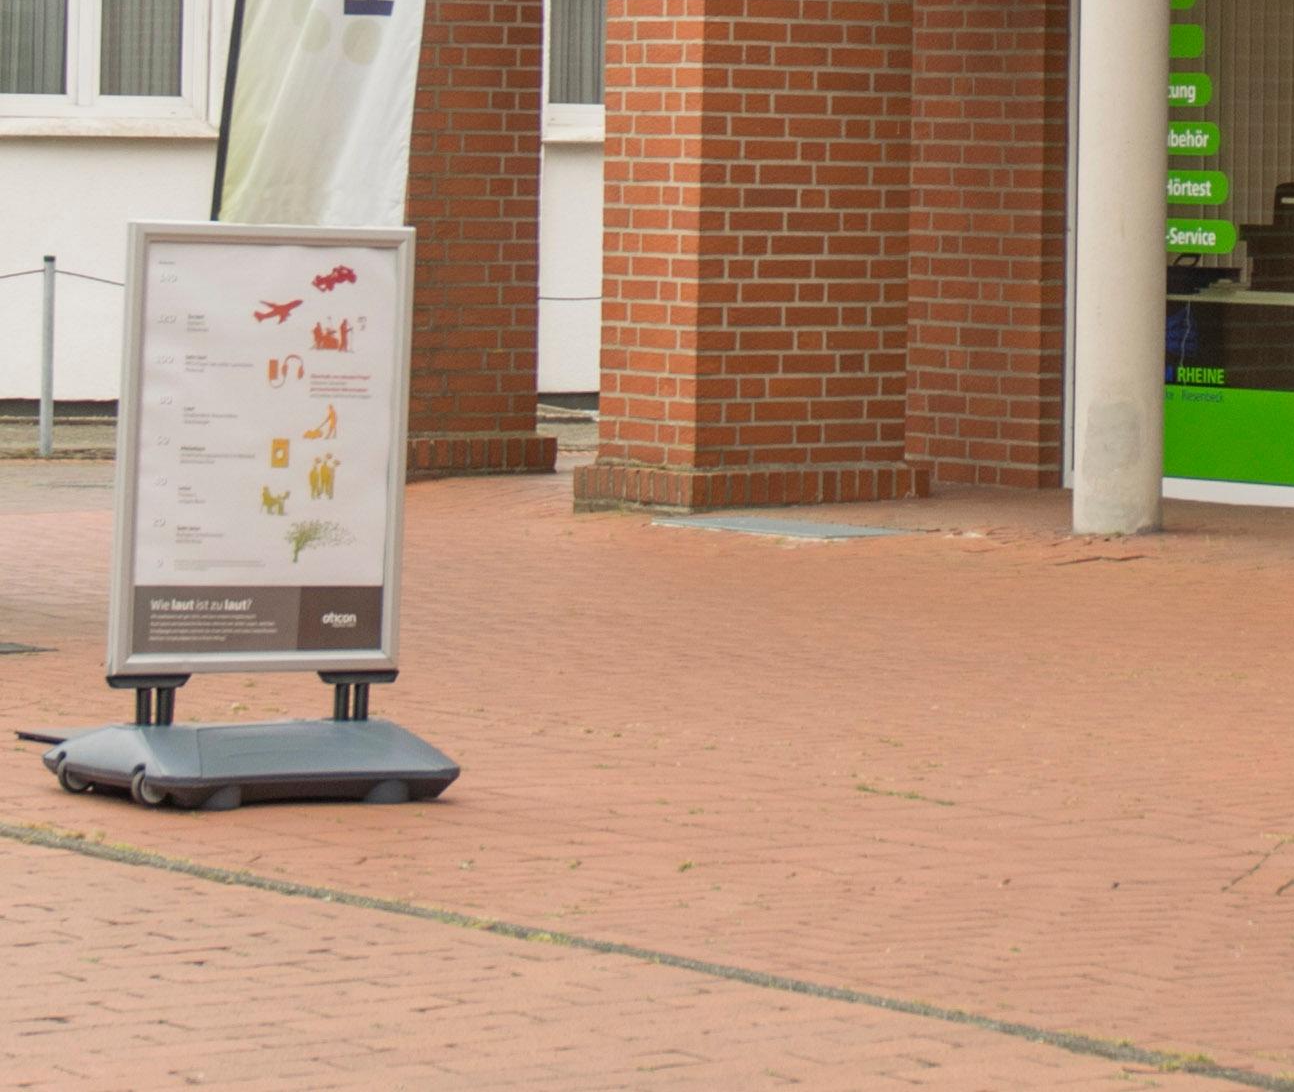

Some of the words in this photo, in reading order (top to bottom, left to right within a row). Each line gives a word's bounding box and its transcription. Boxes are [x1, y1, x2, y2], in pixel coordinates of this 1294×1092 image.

[1177, 366, 1225, 385] RHEINE
[150, 598, 170, 611] Wie
[171, 598, 195, 611] laut
[195, 599, 208, 611] ist
[210, 601, 224, 611] zu
[224, 598, 253, 611] laut?
